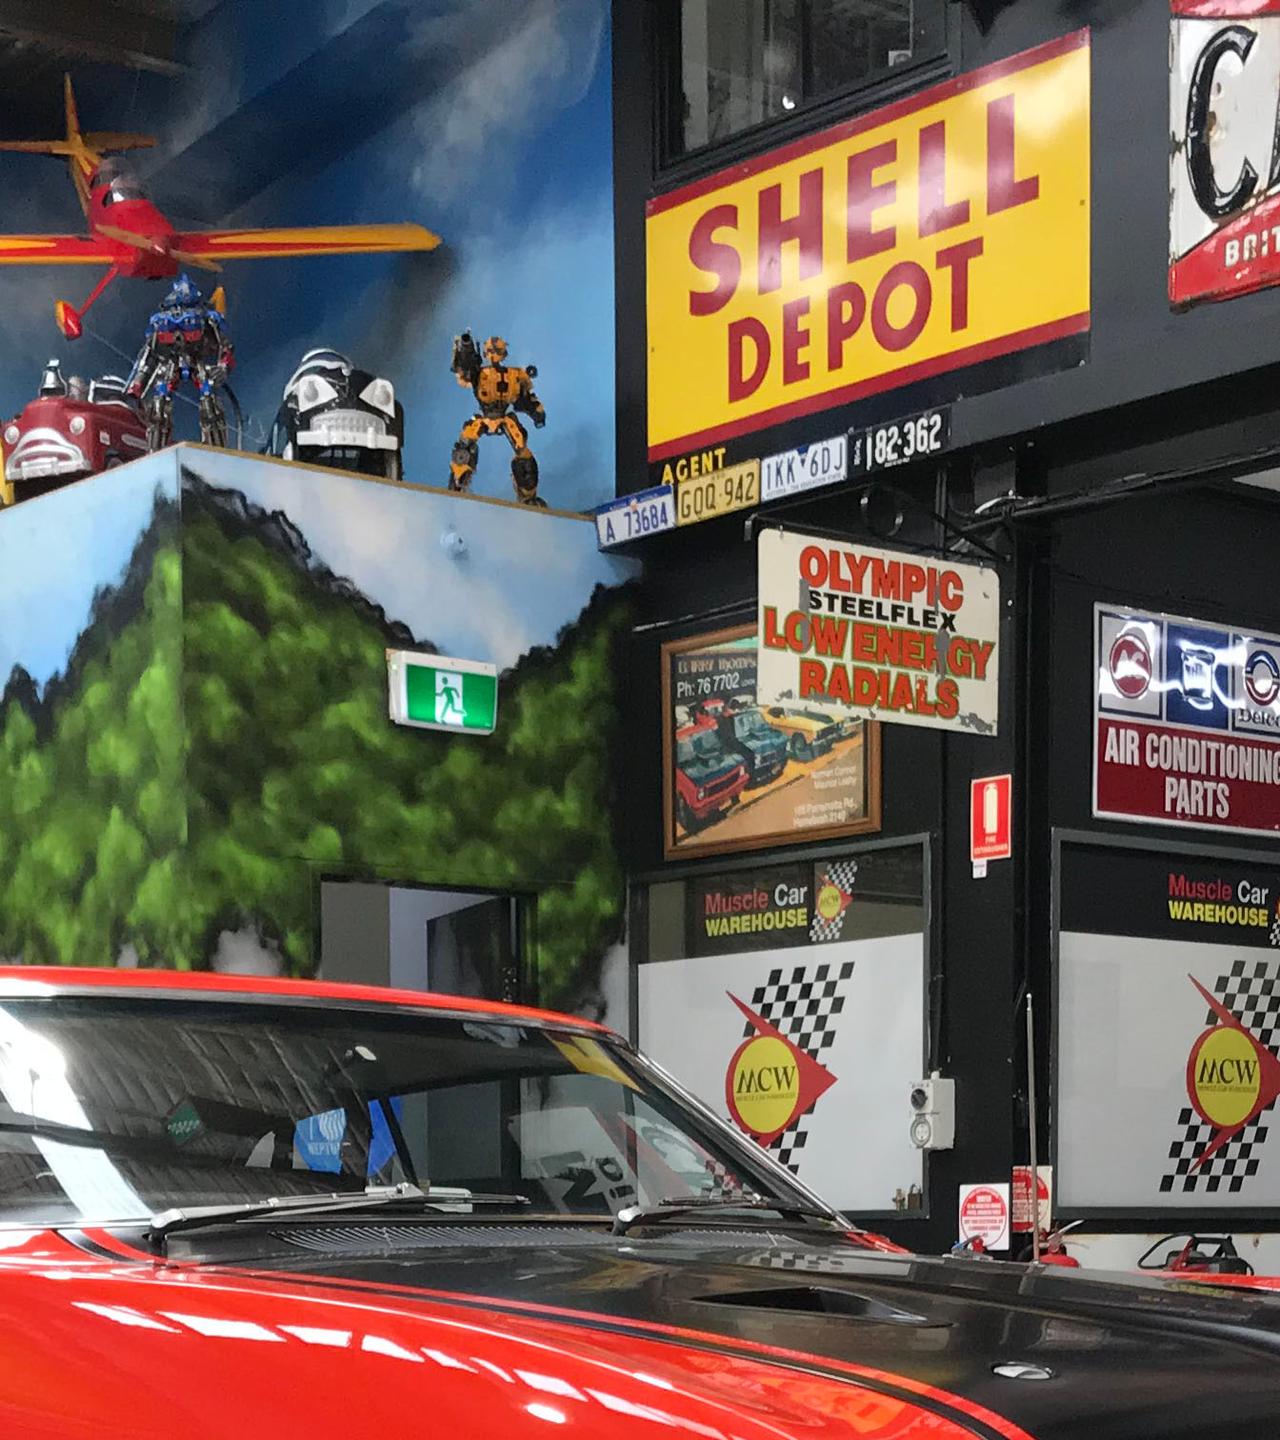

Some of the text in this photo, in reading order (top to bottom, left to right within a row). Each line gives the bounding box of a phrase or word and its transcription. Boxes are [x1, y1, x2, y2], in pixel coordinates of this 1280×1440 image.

[688, 92, 1040, 317] SHELL
[727, 236, 984, 404] DEPOT
[661, 447, 727, 485] AGENT
[810, 441, 843, 477] 6DJ
[605, 518, 616, 542] A
[624, 501, 668, 537] 73684
[799, 545, 964, 612] OLYMPIC
[807, 589, 957, 633] STEELFLEX
[763, 605, 848, 660] LOW
[676, 680, 696, 699] Ph:
[697, 676, 711, 695] 76
[712, 671, 740, 692] 7702
[799, 657, 960, 720] RADIALS
[1104, 726, 1140, 767] AIR
[1164, 776, 1230, 820] PARTS
[705, 883, 808, 914] Muscle Car
[1167, 873, 1269, 905] Muscle Car
[705, 907, 808, 938] WAREHOUSE
[1167, 899, 1269, 928] WAREHOUSE
[736, 1065, 796, 1094] MCW
[1197, 1058, 1258, 1085] MCW
